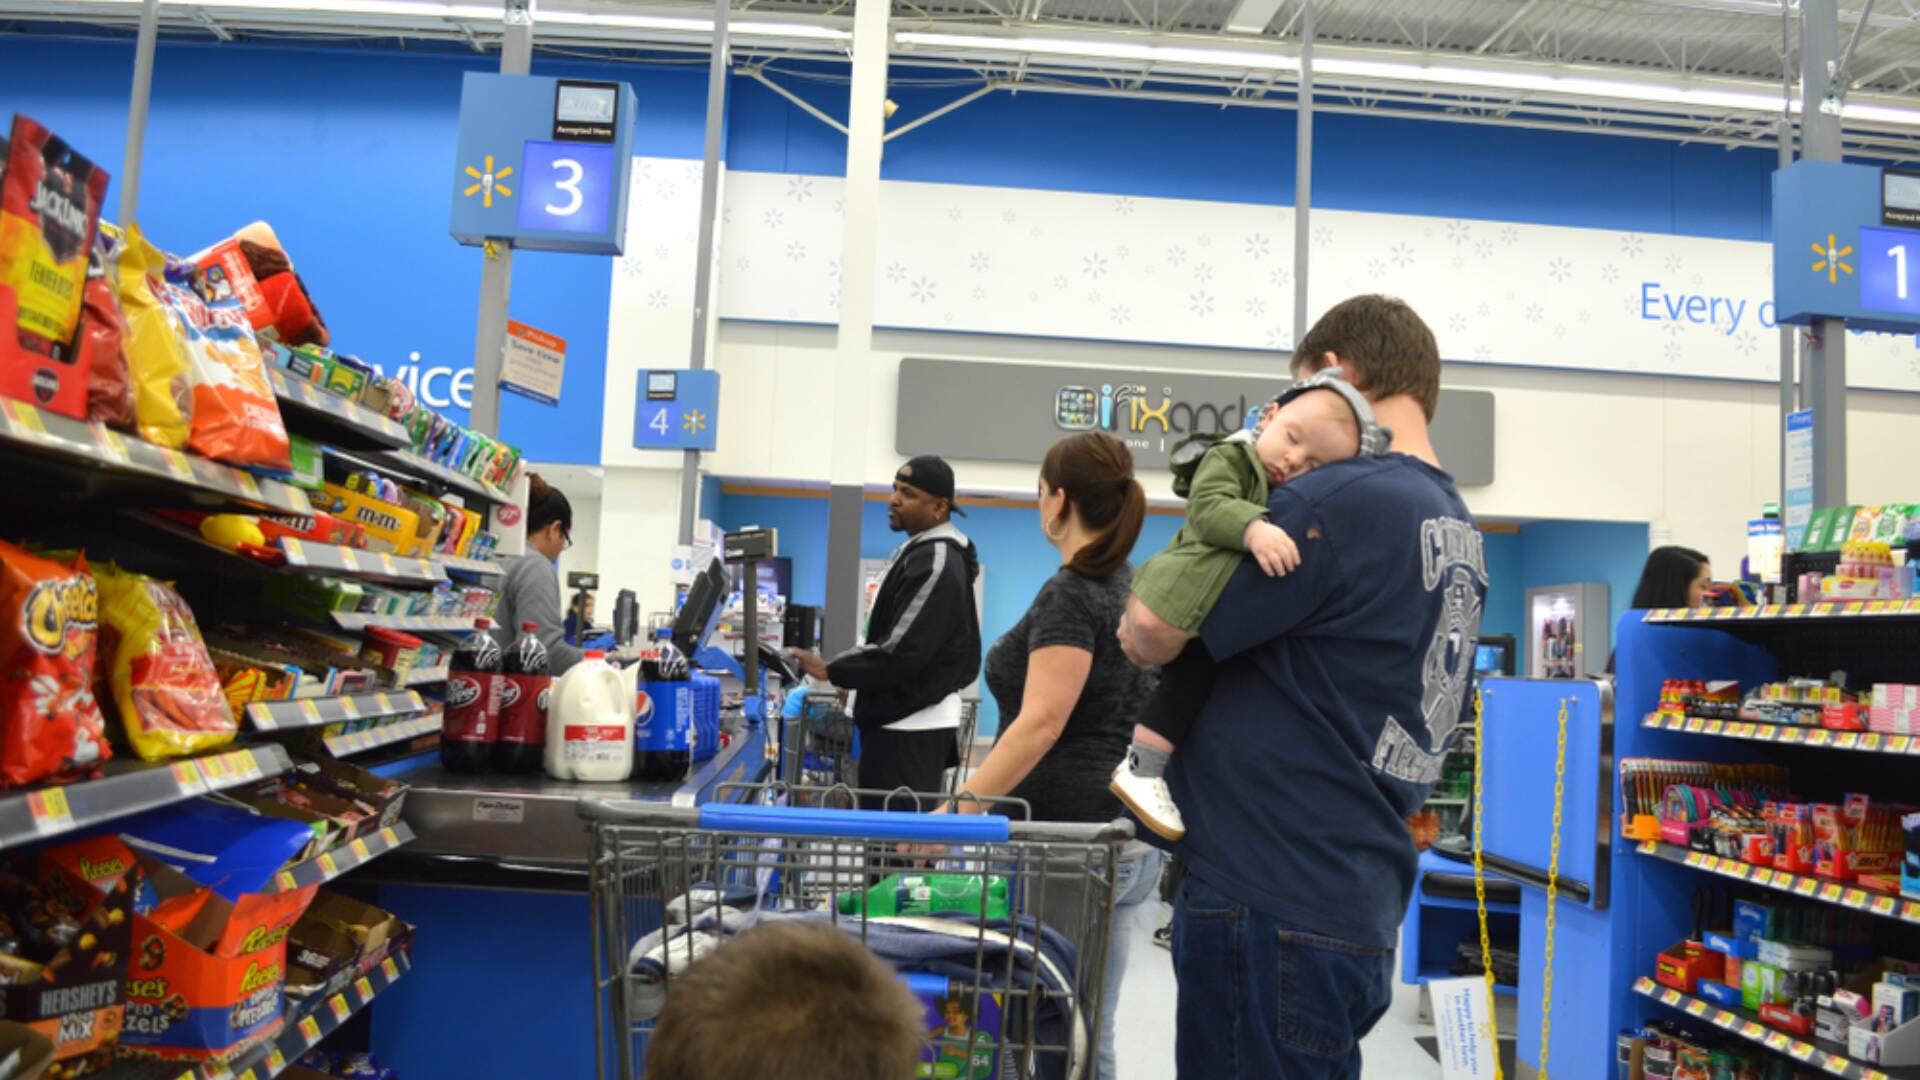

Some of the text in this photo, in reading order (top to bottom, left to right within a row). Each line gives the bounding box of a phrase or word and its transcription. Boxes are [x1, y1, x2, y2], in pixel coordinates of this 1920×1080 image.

[593, 127, 612, 136] Here
[544, 158, 584, 217] 3
[1887, 245, 1908, 300] 1
[1641, 281, 1747, 336] Every
[648, 407, 670, 437] 4
[40, 980, 117, 1016] HERSHEY'S
